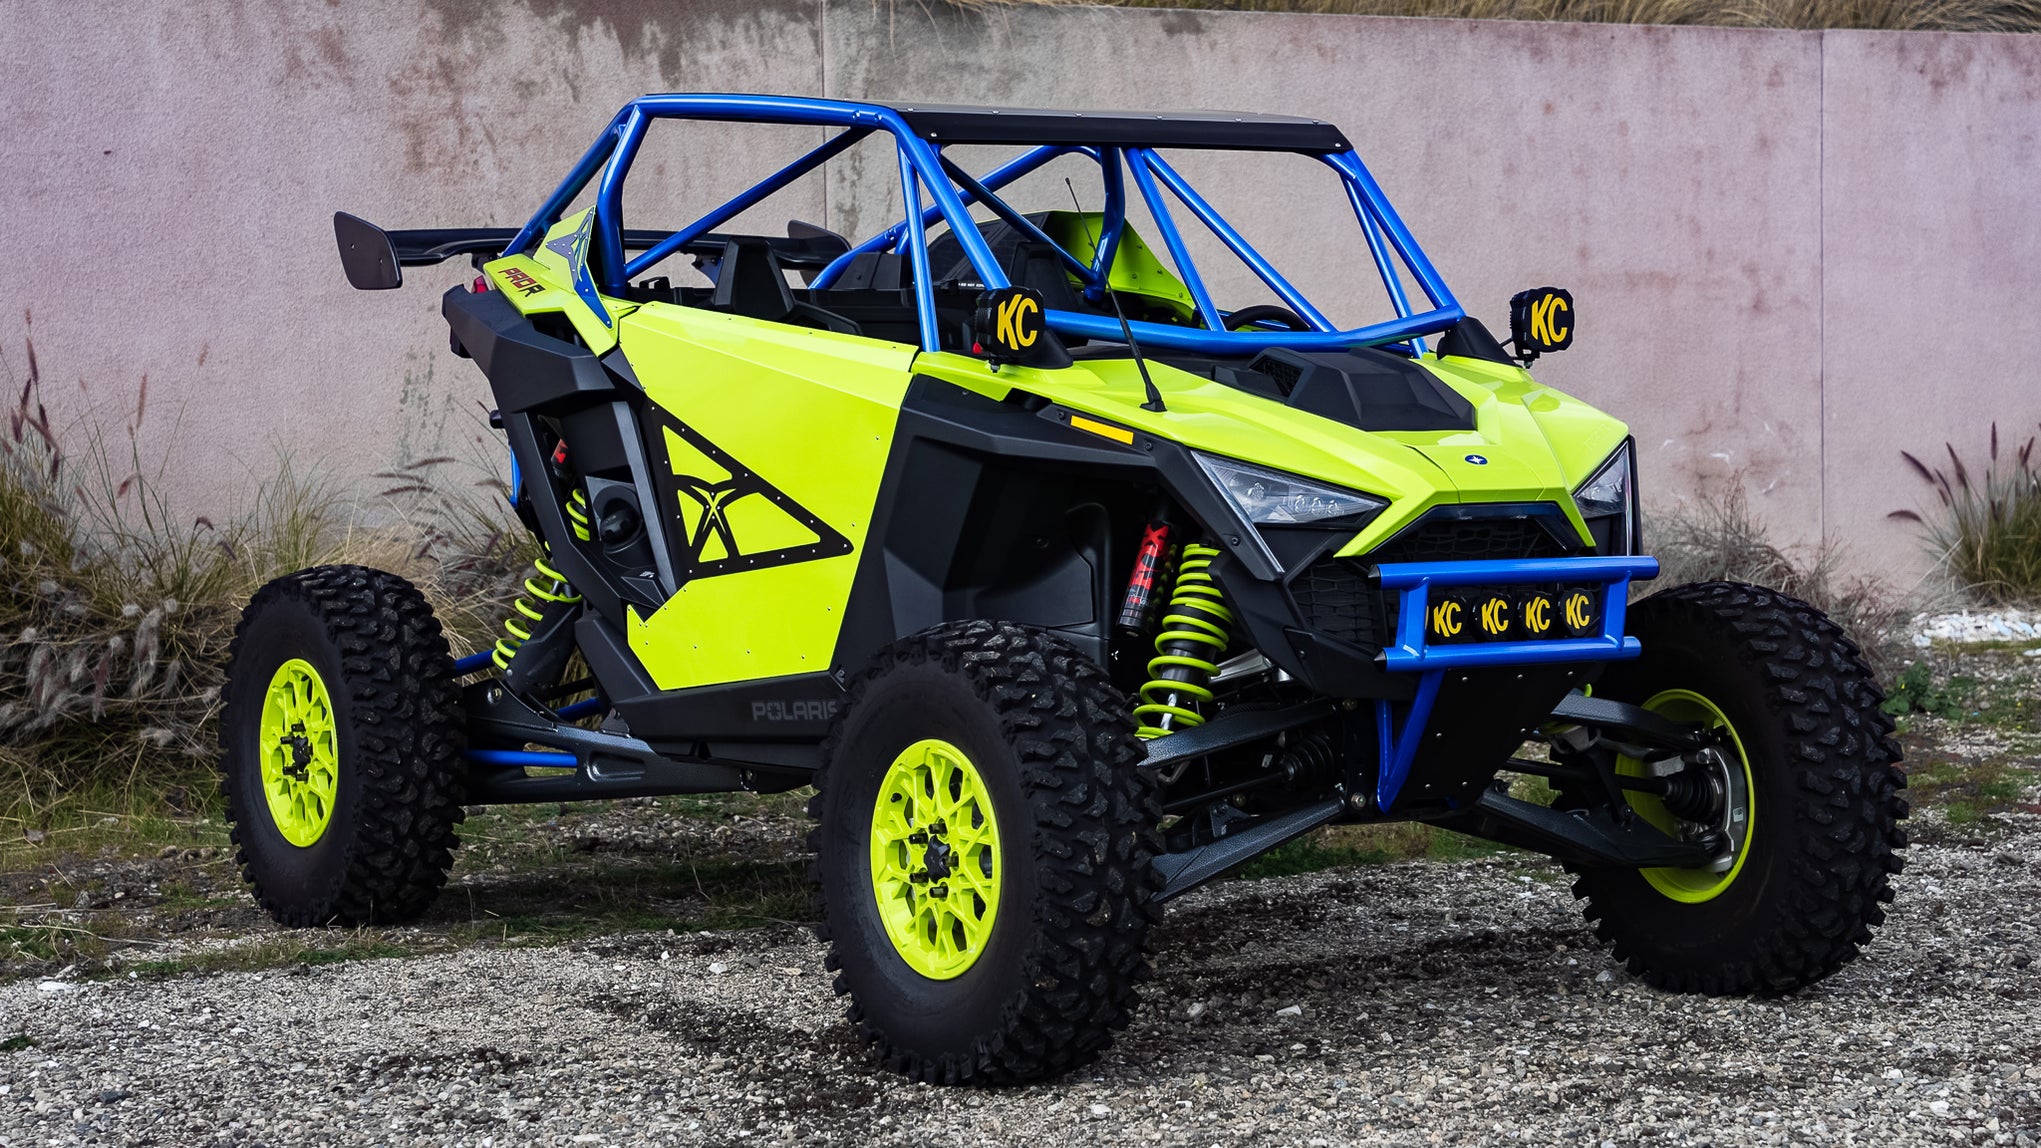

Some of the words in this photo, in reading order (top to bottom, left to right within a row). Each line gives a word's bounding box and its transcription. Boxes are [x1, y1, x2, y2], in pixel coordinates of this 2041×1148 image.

[997, 294, 1038, 350] KC
[1531, 294, 1568, 346] KC
[1433, 601, 1462, 637] KC
[1481, 598, 1509, 634] KC
[1525, 597, 1551, 633] KC
[1566, 593, 1590, 630] KC
